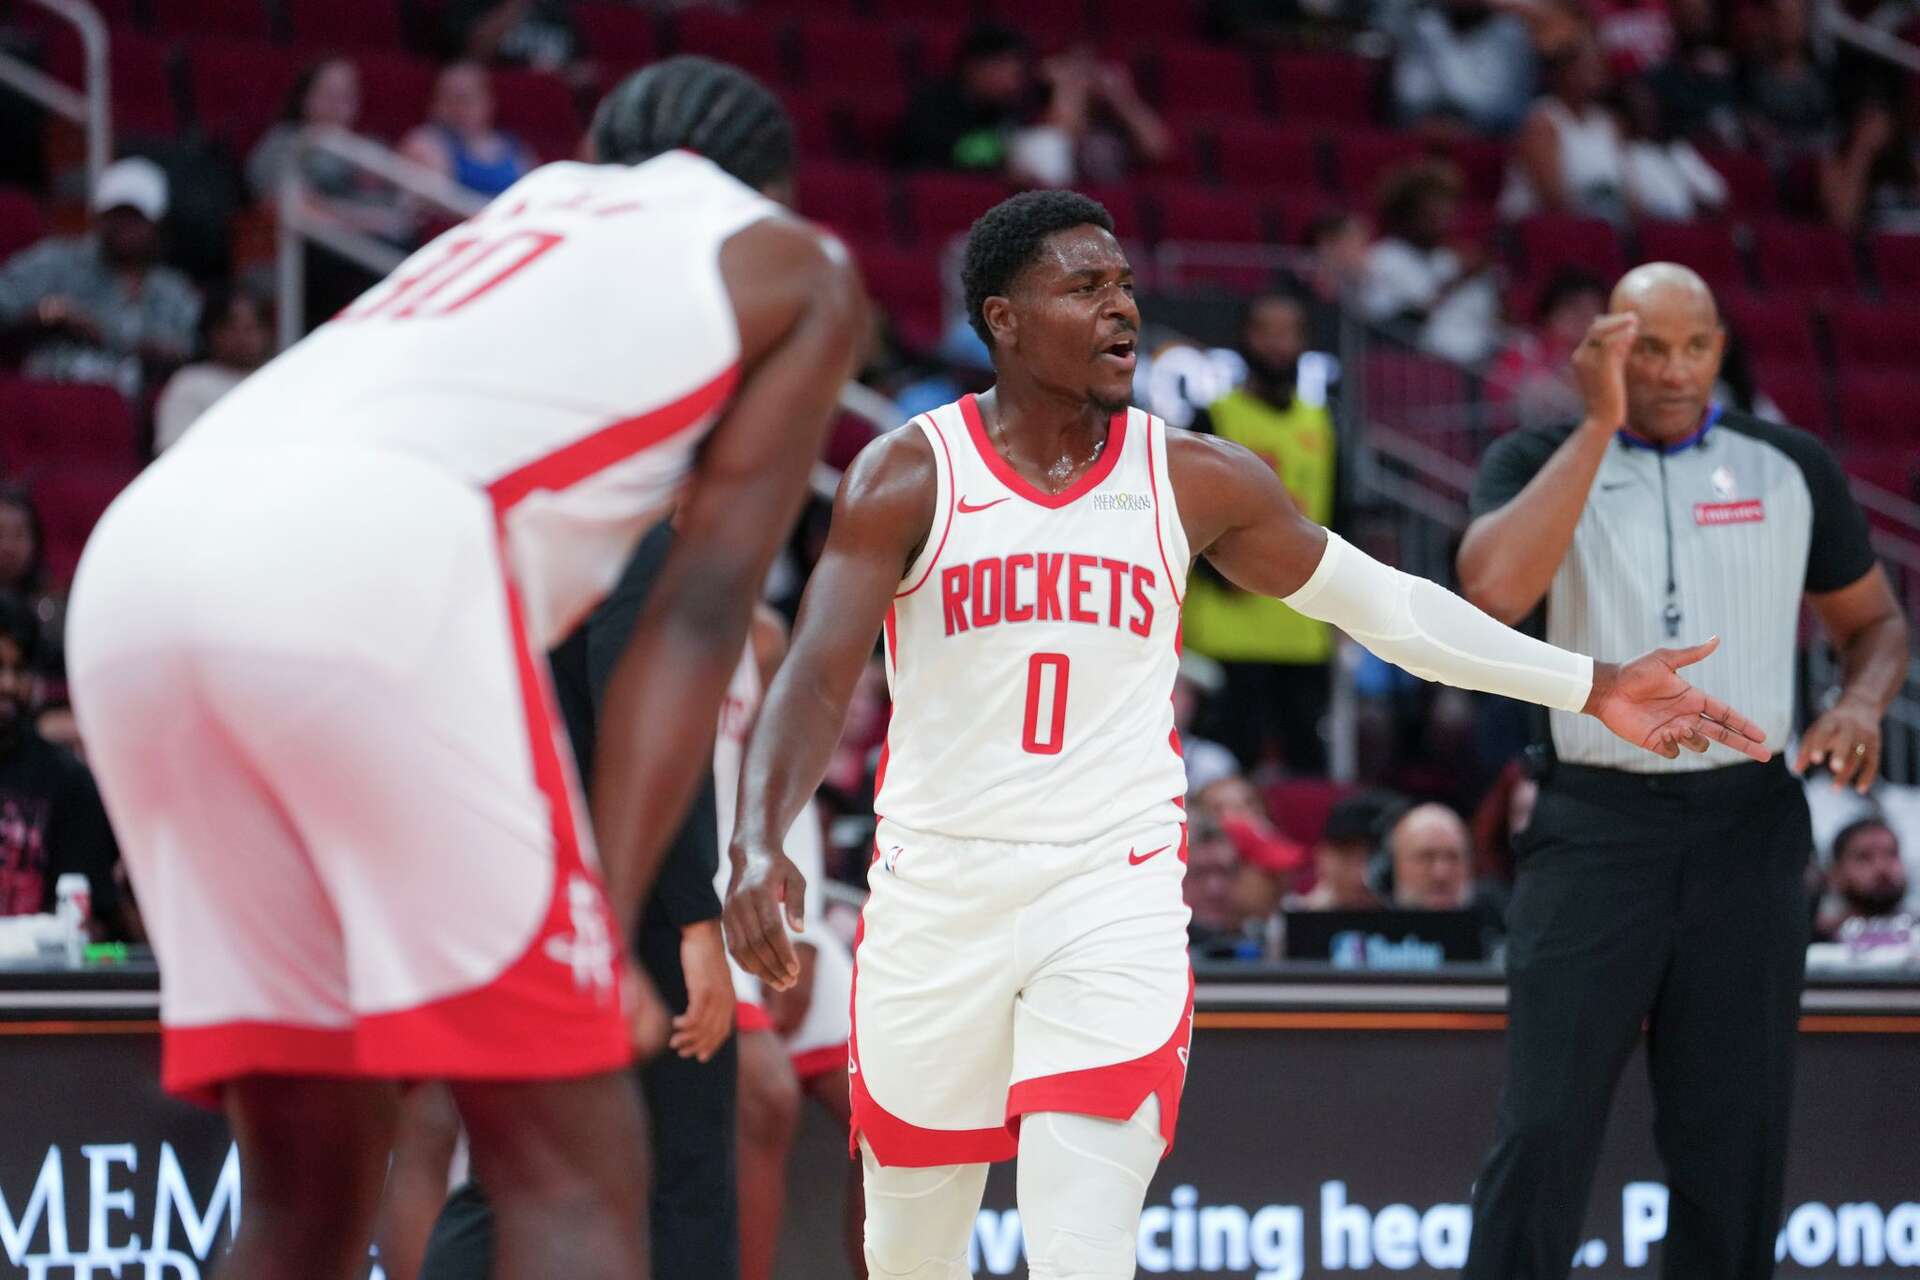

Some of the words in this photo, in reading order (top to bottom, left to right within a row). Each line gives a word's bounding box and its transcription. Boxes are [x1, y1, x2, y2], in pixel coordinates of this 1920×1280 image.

[1093, 492, 1151, 504] MEMORIAL
[1093, 501, 1151, 511] HERMANN
[941, 551, 1157, 639] ROCKETS
[1021, 652, 1071, 755] 0
